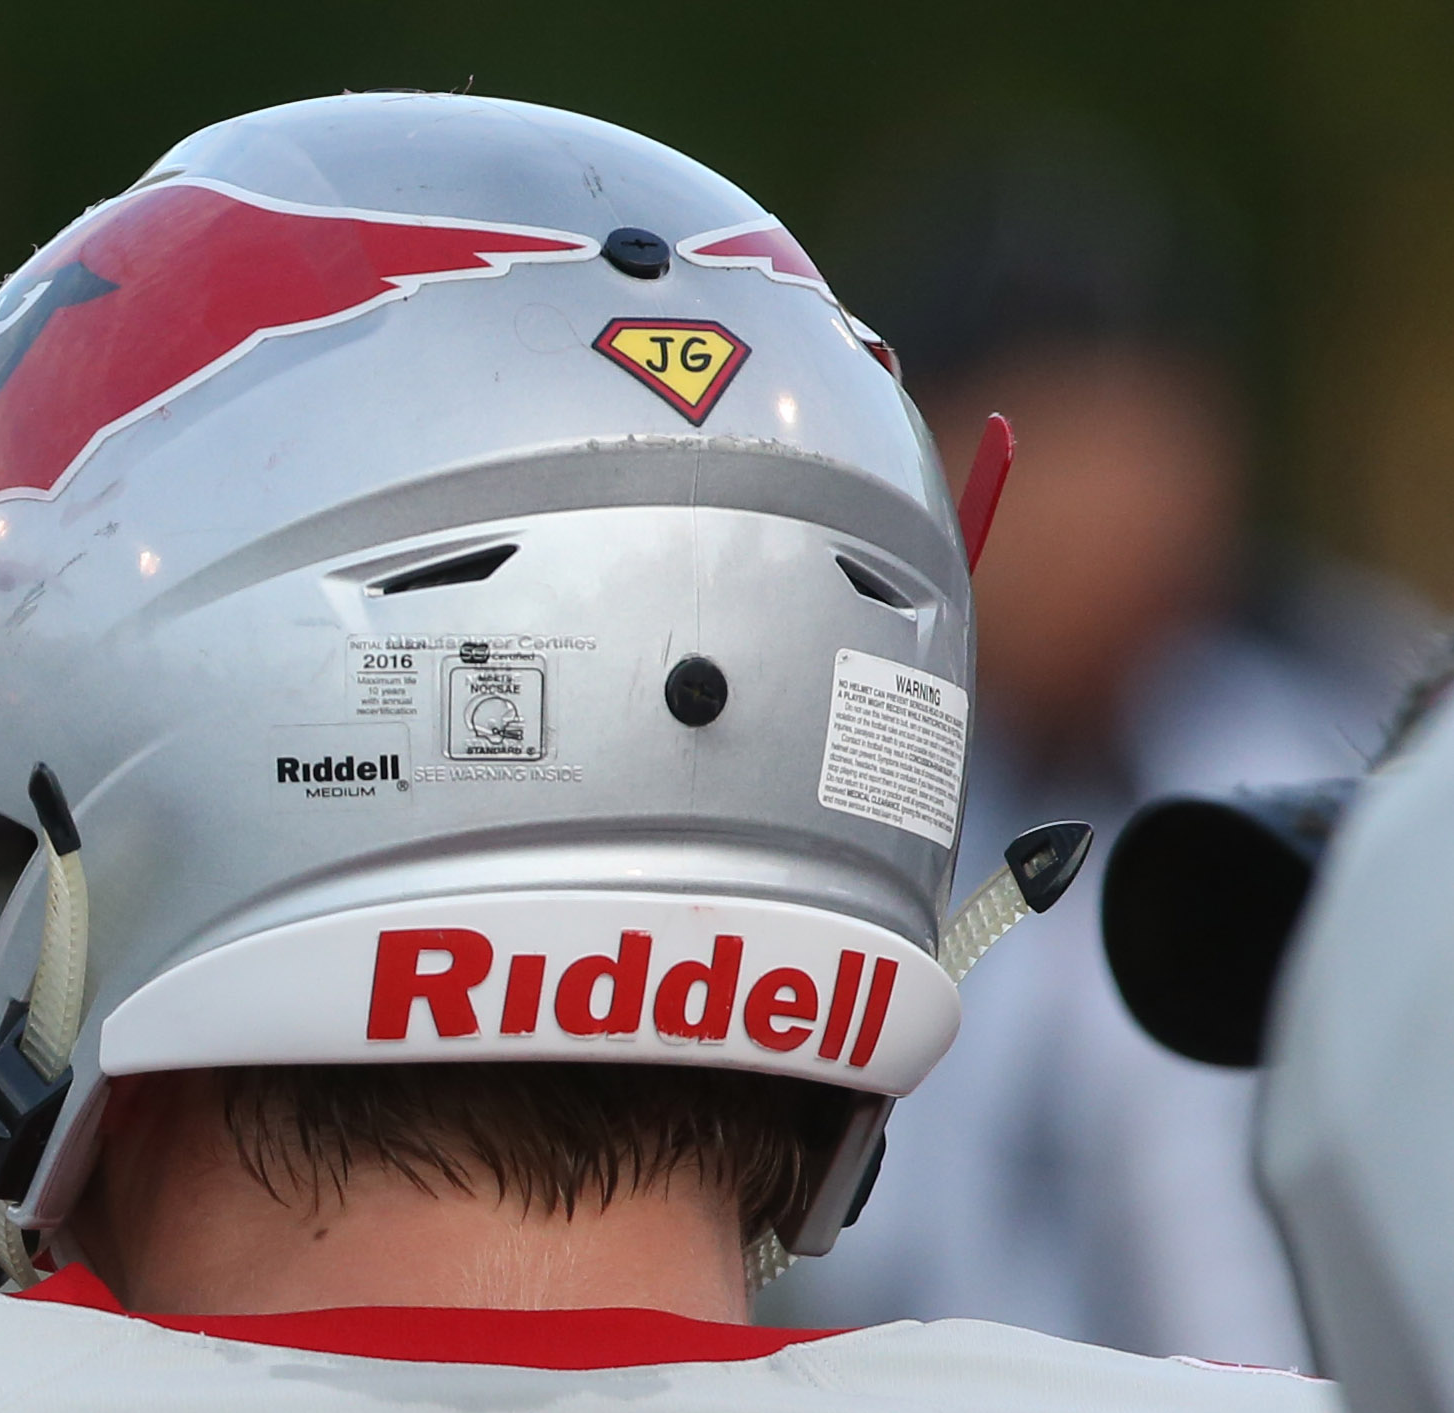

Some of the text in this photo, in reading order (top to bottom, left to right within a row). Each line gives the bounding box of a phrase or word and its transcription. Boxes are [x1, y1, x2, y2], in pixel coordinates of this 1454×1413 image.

[646, 337, 712, 373] JG
[349, 641, 382, 650] INITIAL
[517, 635, 597, 650] Certifies
[363, 653, 414, 669] 2016
[356, 676, 417, 685] Maximum life
[368, 687, 406, 696] 10 years
[471, 684, 521, 694] NOCSAE
[896, 674, 942, 706] WARNING
[361, 697, 413, 705] with annual
[356, 706, 418, 715] recertification
[466, 746, 522, 755] STANDARD
[276, 755, 401, 783] Riddell
[414, 765, 584, 783] SEE WARNING INSIDE
[305, 787, 376, 799] MEDIUM
[367, 927, 900, 1069] Riddell
